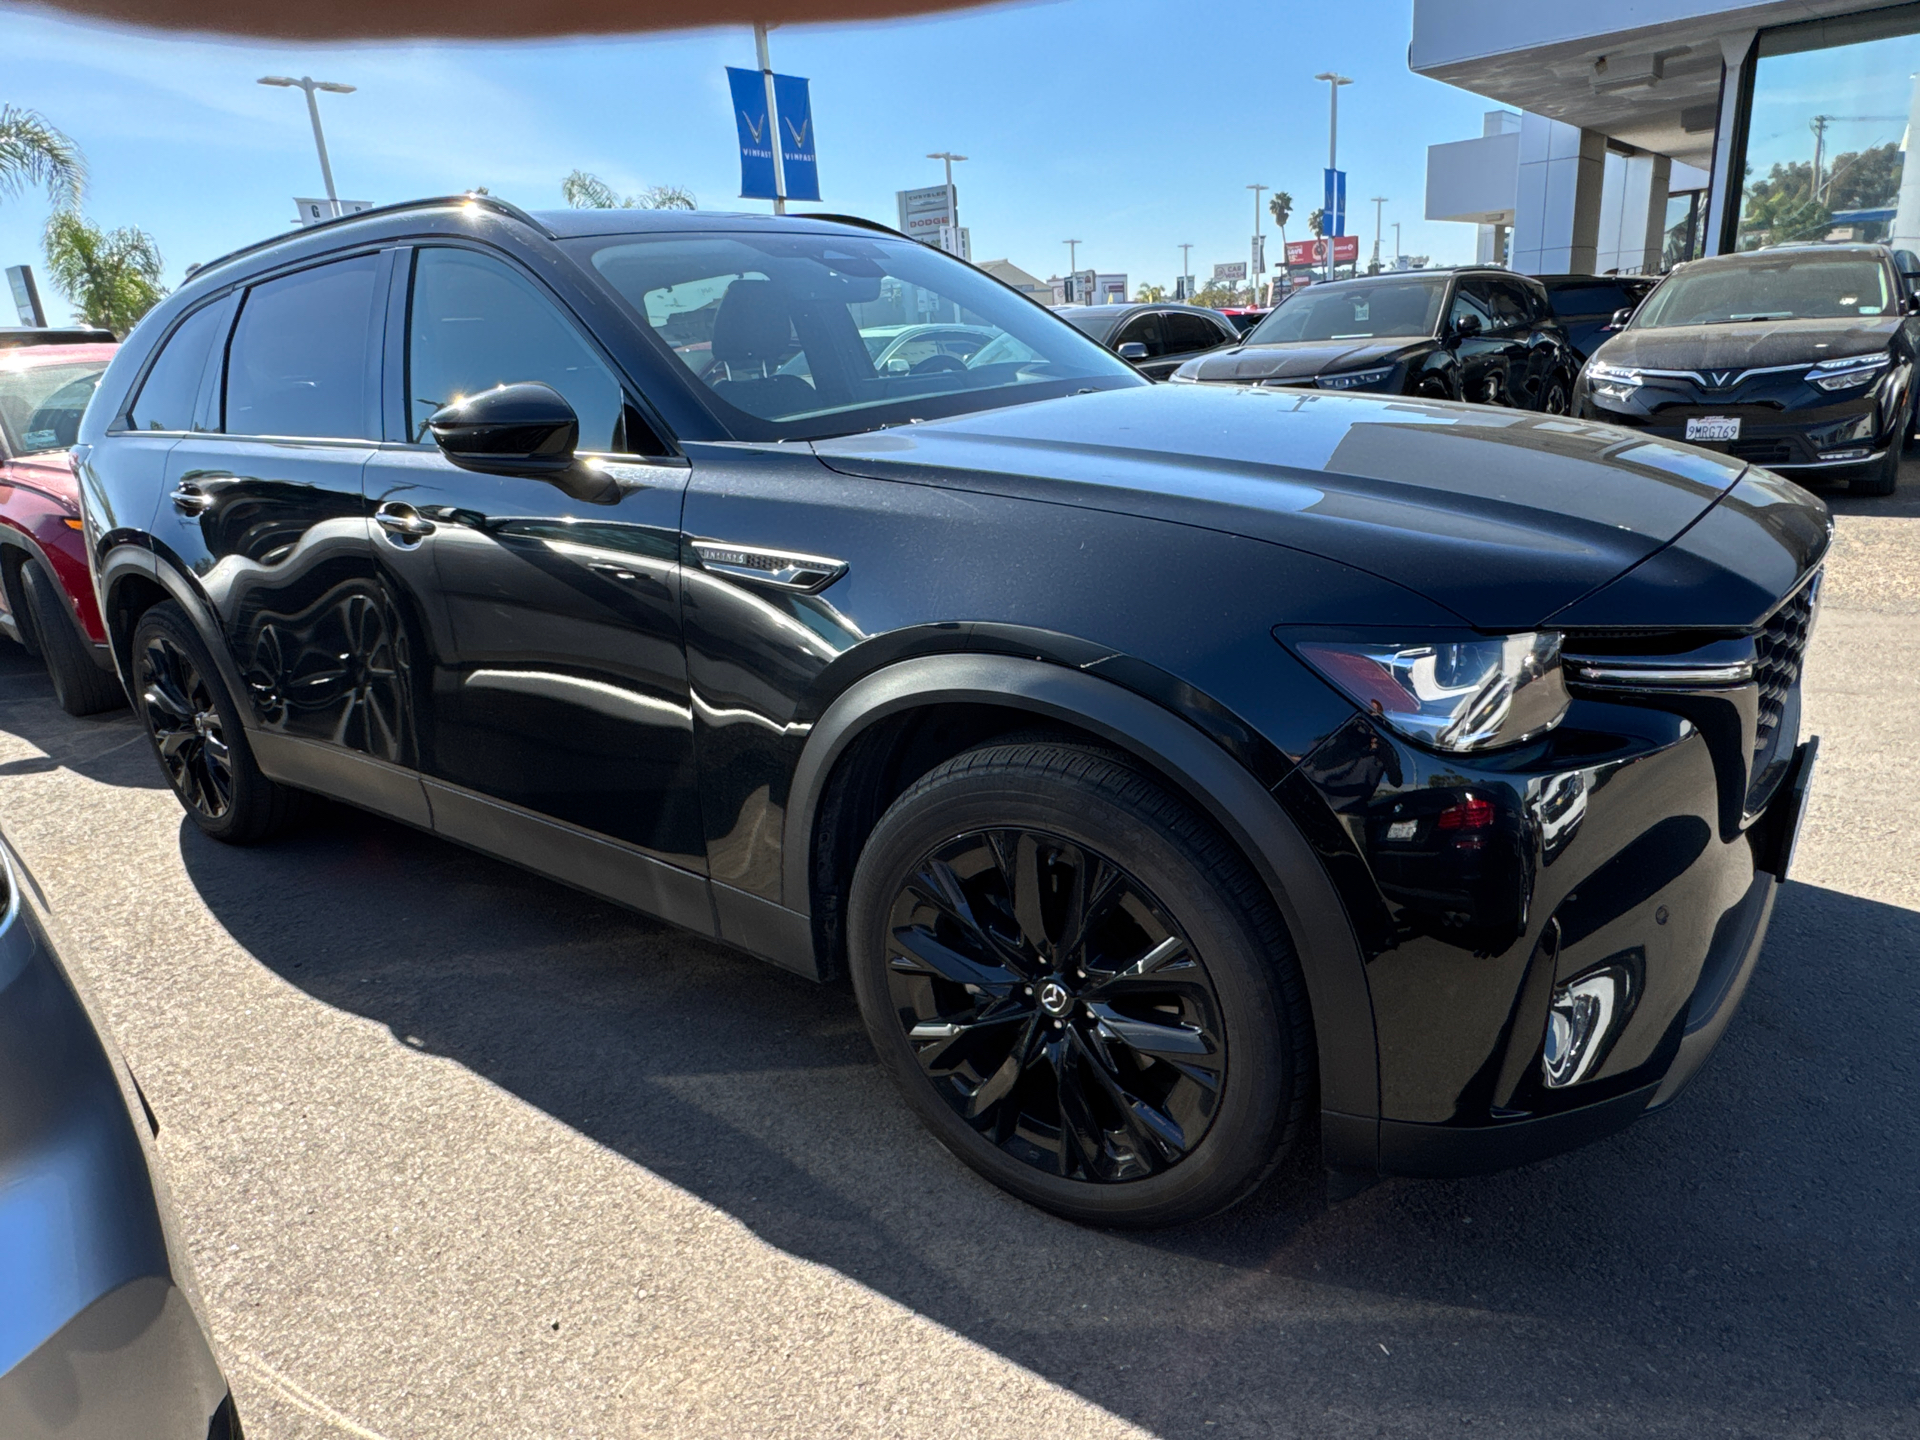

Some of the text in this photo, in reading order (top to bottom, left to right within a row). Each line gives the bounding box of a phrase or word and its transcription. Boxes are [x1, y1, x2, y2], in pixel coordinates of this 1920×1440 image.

[742, 148, 772, 159] VINFAST
[784, 152, 815, 162] VINFAST
[909, 216, 949, 228] DODGE
[1227, 265, 1242, 273] CAR
[1225, 271, 1245, 279] WASH
[1687, 425, 1738, 439] 9MRG769
